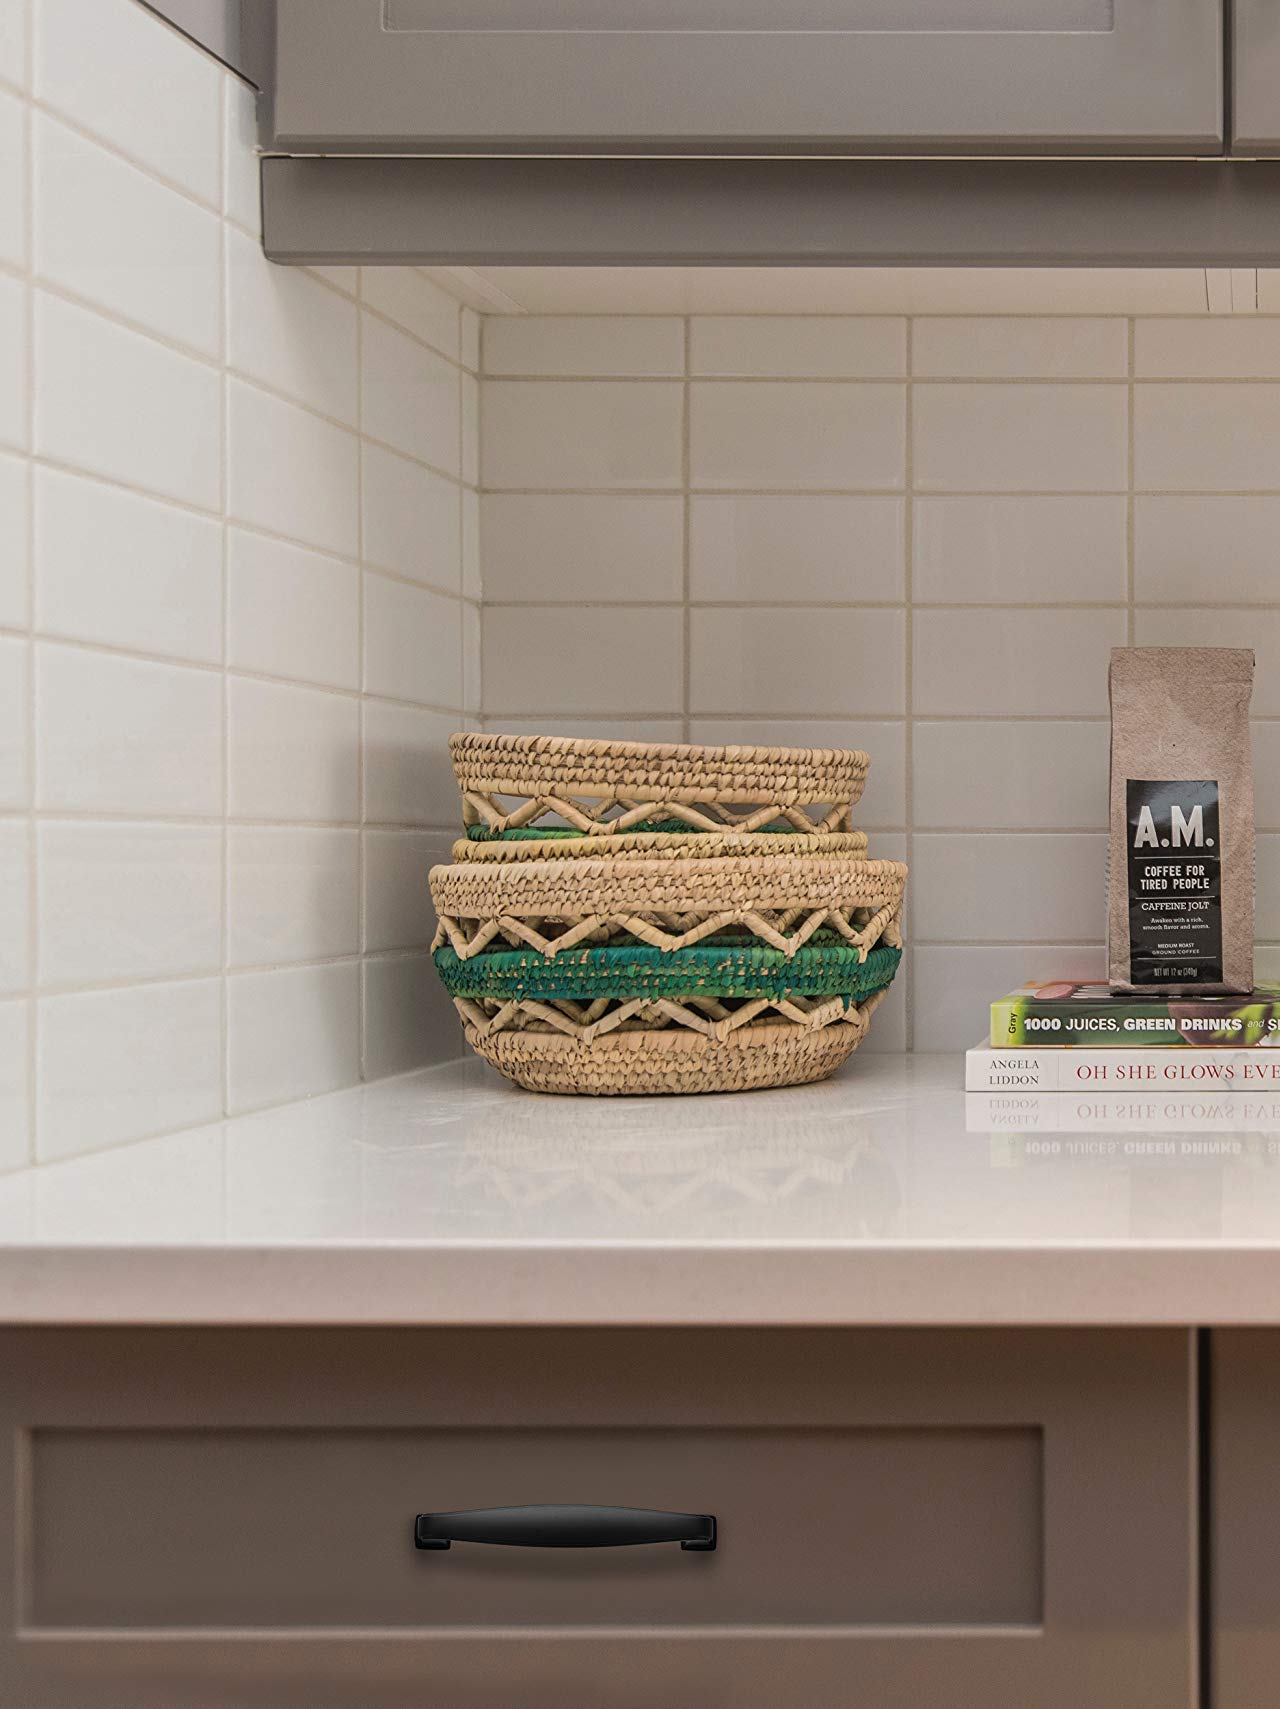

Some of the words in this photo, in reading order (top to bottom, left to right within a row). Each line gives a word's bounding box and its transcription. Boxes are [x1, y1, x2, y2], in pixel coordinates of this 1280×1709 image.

[1133, 805, 1215, 848] A.M.
[1144, 865, 1182, 877] COFFEE
[1186, 865, 1205, 876] FOR
[1140, 879, 1168, 890] TIRED
[1173, 878, 1210, 890] PEOPLE
[1141, 902, 1187, 911] CAFFEINE
[1187, 901, 1210, 912] JOLT
[1153, 967, 1162, 977] NET
[1008, 1012, 1018, 1034] Gray
[1024, 1018, 1061, 1031] 1000
[1065, 1018, 1120, 1032] JUICES,
[1123, 1018, 1176, 1031] GREEN
[1181, 1018, 1242, 1031] DRINKS
[1247, 1019, 1265, 1028] and
[990, 1059, 1040, 1070] ANGELA
[1076, 1065, 1107, 1080] OH
[1116, 1065, 1157, 1080] SHE
[1164, 1065, 1235, 1080] GLOWS
[989, 1075, 1040, 1085] LIDDON
